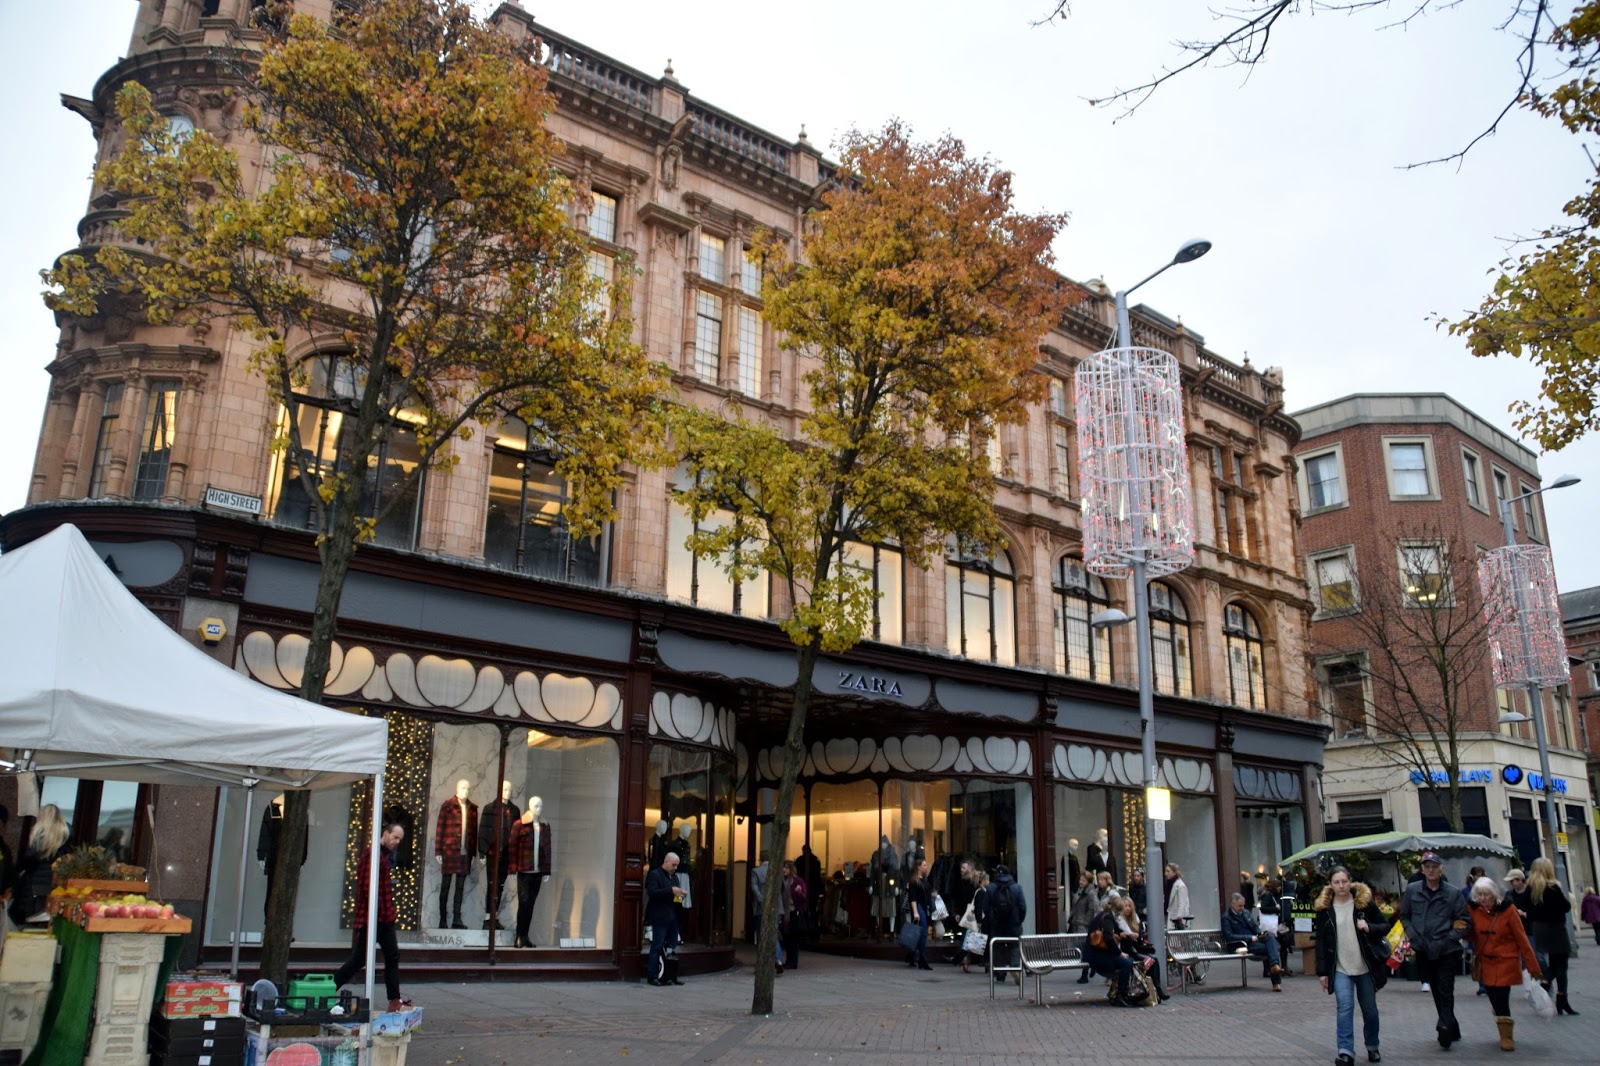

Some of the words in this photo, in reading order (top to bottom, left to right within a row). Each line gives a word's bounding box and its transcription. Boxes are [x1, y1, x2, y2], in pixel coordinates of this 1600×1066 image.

[208, 489, 230, 505] HIGH
[230, 494, 259, 511] STREET
[207, 624, 220, 634] ADT
[839, 671, 903, 697] ZARA
[1429, 768, 1493, 783] BALAYS
